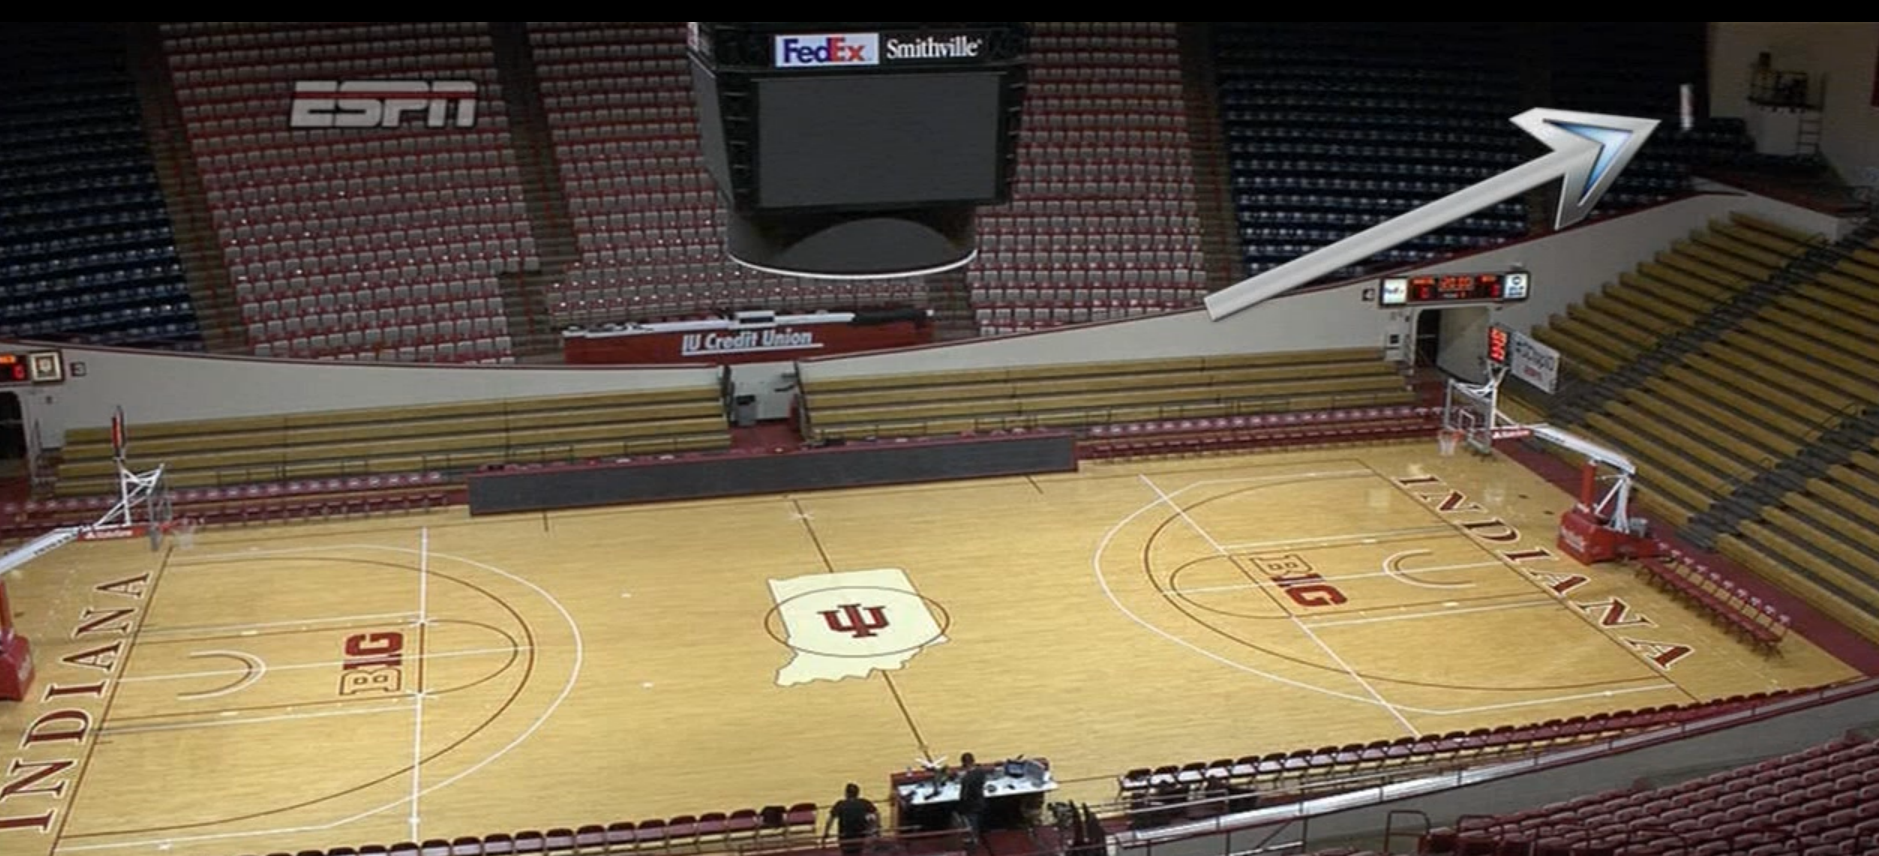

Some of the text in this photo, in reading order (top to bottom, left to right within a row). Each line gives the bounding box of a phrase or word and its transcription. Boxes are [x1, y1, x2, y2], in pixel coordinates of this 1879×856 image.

[784, 37, 866, 63] FedEx
[886, 36, 979, 60] Smithville
[681, 328, 813, 352] IU Credit Union
[1391, 474, 1696, 671] INDIANA
[0, 571, 153, 834] INDIANA
